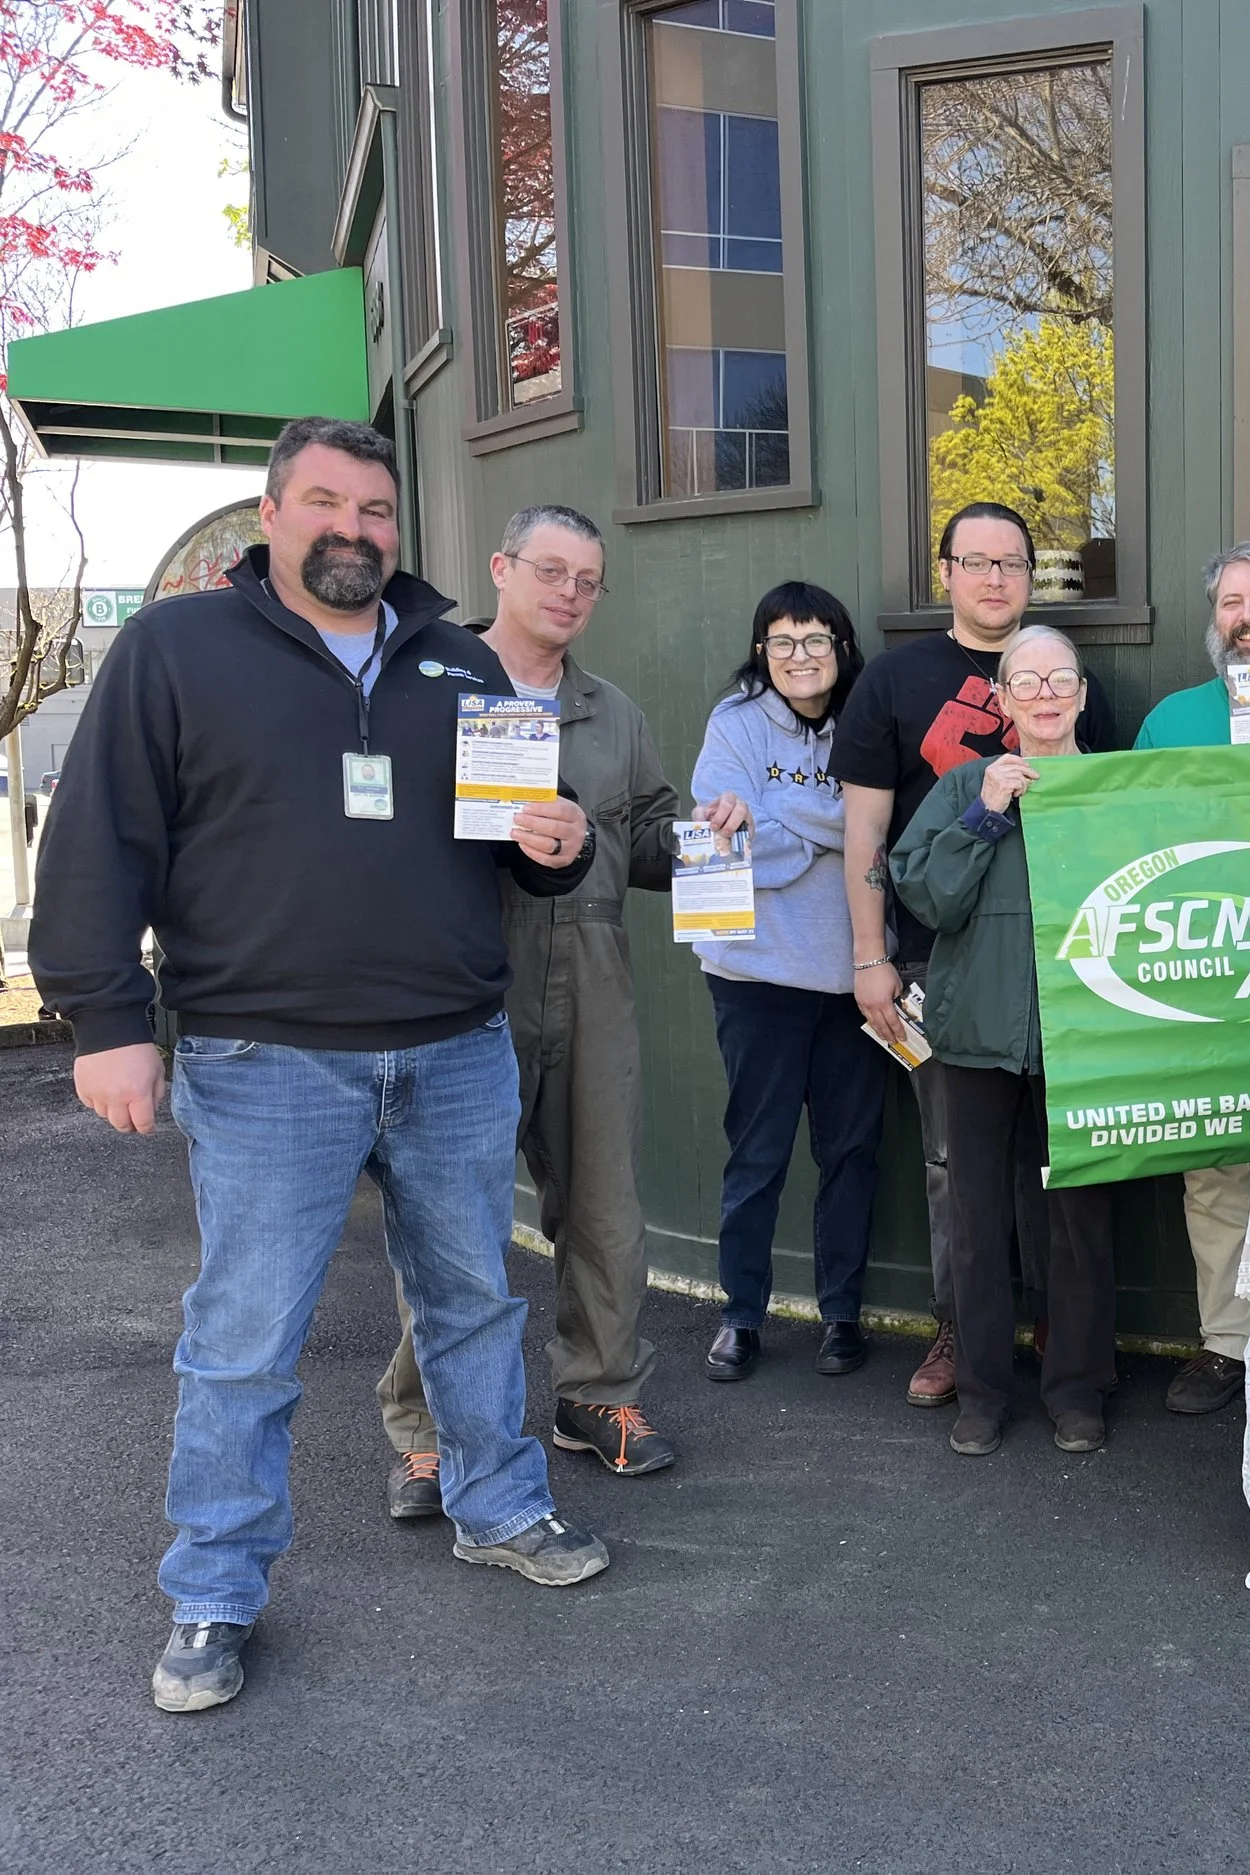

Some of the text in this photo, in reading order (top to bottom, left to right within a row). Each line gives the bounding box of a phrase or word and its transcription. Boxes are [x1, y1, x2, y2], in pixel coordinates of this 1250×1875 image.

[463, 699, 484, 707] LISA
[684, 829, 711, 840] LISA
[1104, 848, 1180, 902] OREGON
[1138, 956, 1235, 983] COUNCIL
[1066, 1102, 1166, 1130] UNITED
[1172, 1097, 1213, 1119] WE
[1091, 1120, 1198, 1147] DIVIDED
[1204, 1115, 1243, 1137] WE
